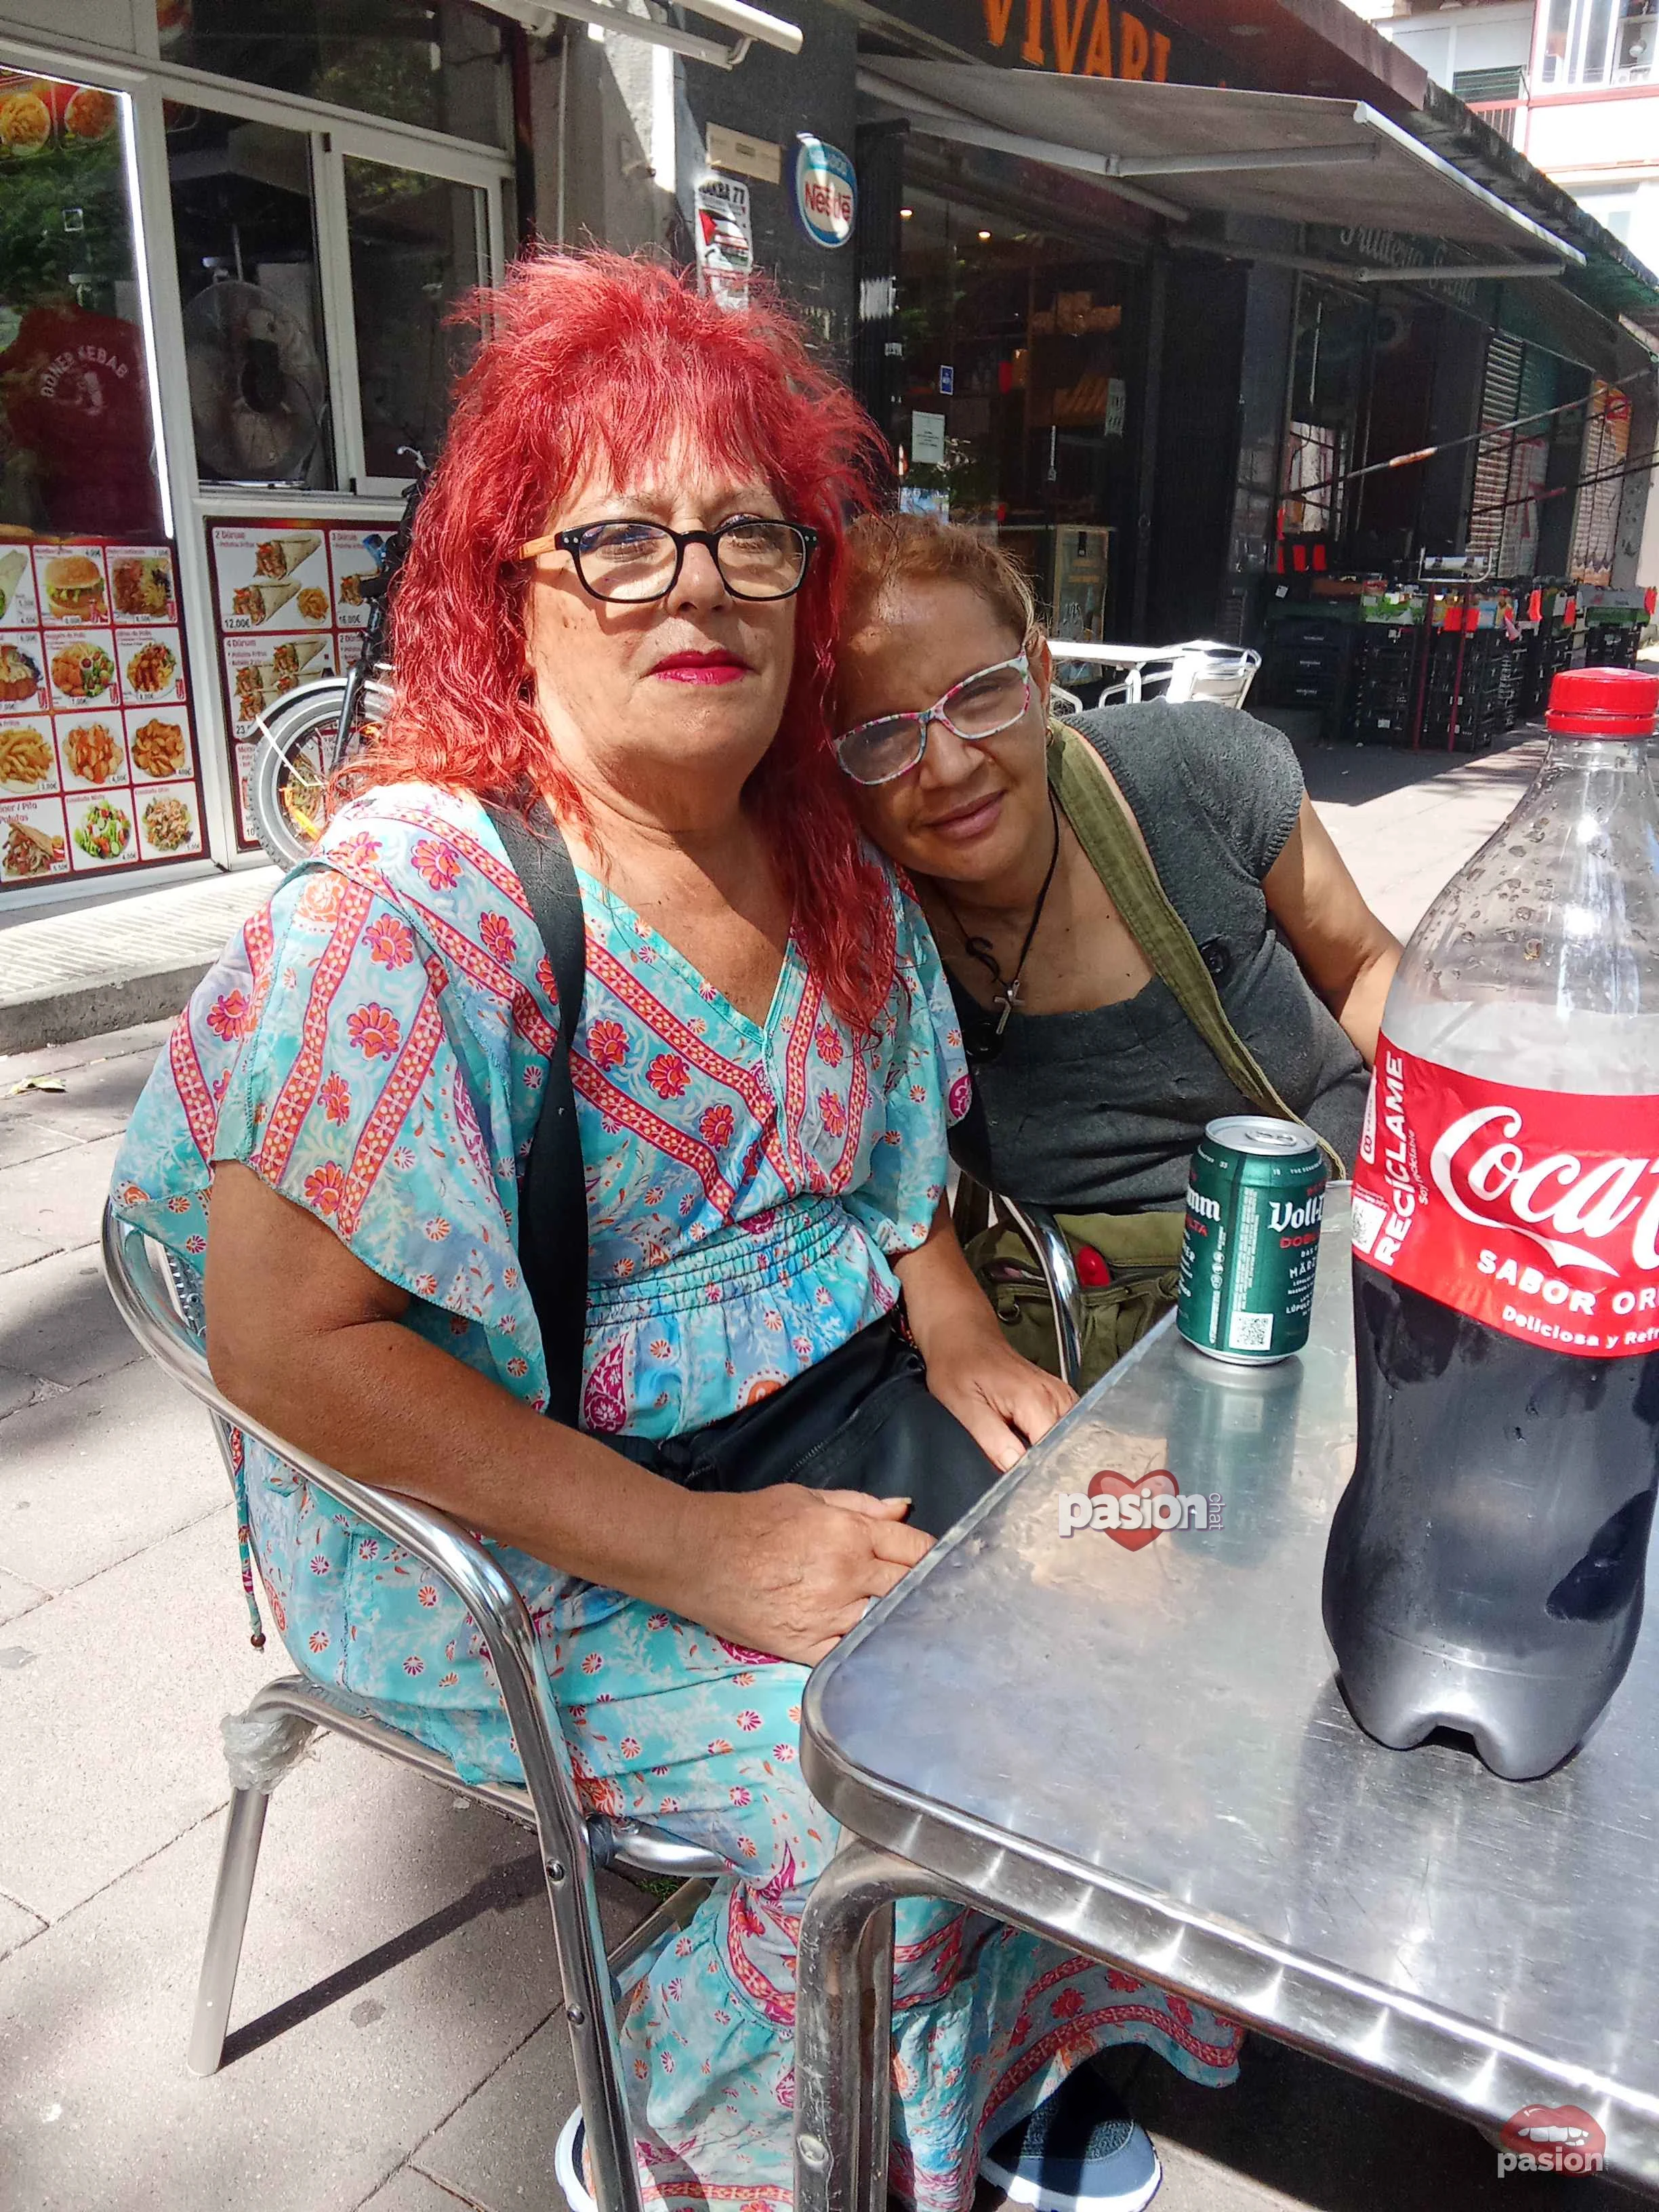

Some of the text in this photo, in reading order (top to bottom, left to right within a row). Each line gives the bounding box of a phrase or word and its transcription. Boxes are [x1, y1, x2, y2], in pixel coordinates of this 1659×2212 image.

[1374, 1050, 1416, 1267] RECÍCLAME
[1430, 1105, 1659, 1277] Coca
[1477, 1248, 1659, 1316] SABOR OR
[1502, 1305, 1599, 1347] Deliciosa
[1605, 1334, 1618, 1349] y
